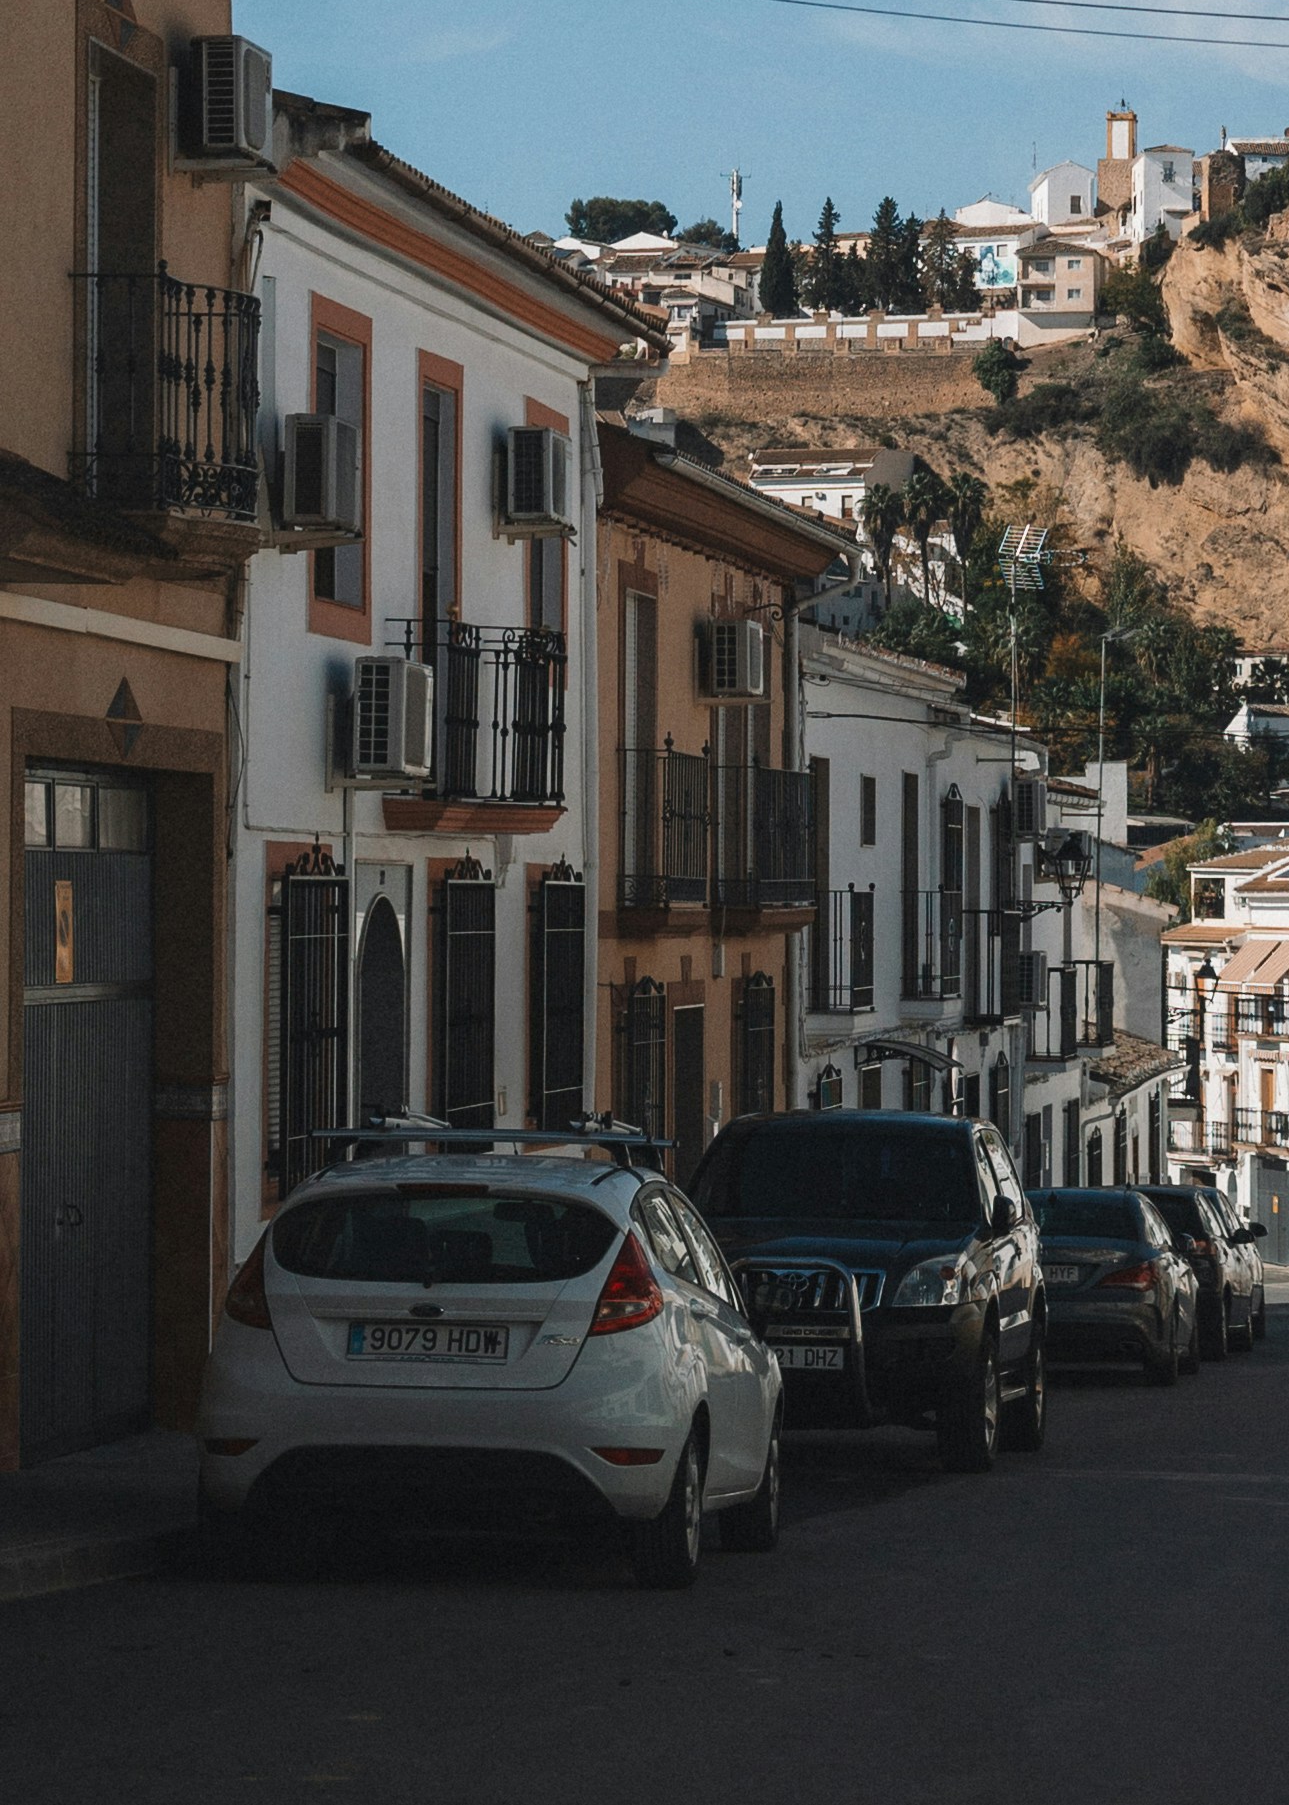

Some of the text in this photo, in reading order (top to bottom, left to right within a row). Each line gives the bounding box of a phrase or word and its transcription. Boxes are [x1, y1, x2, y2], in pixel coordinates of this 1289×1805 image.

[1049, 1267, 1074, 1279] HYF
[369, 1327, 499, 1355] 9079 HDW
[774, 1348, 838, 1367] 21 DHZ
